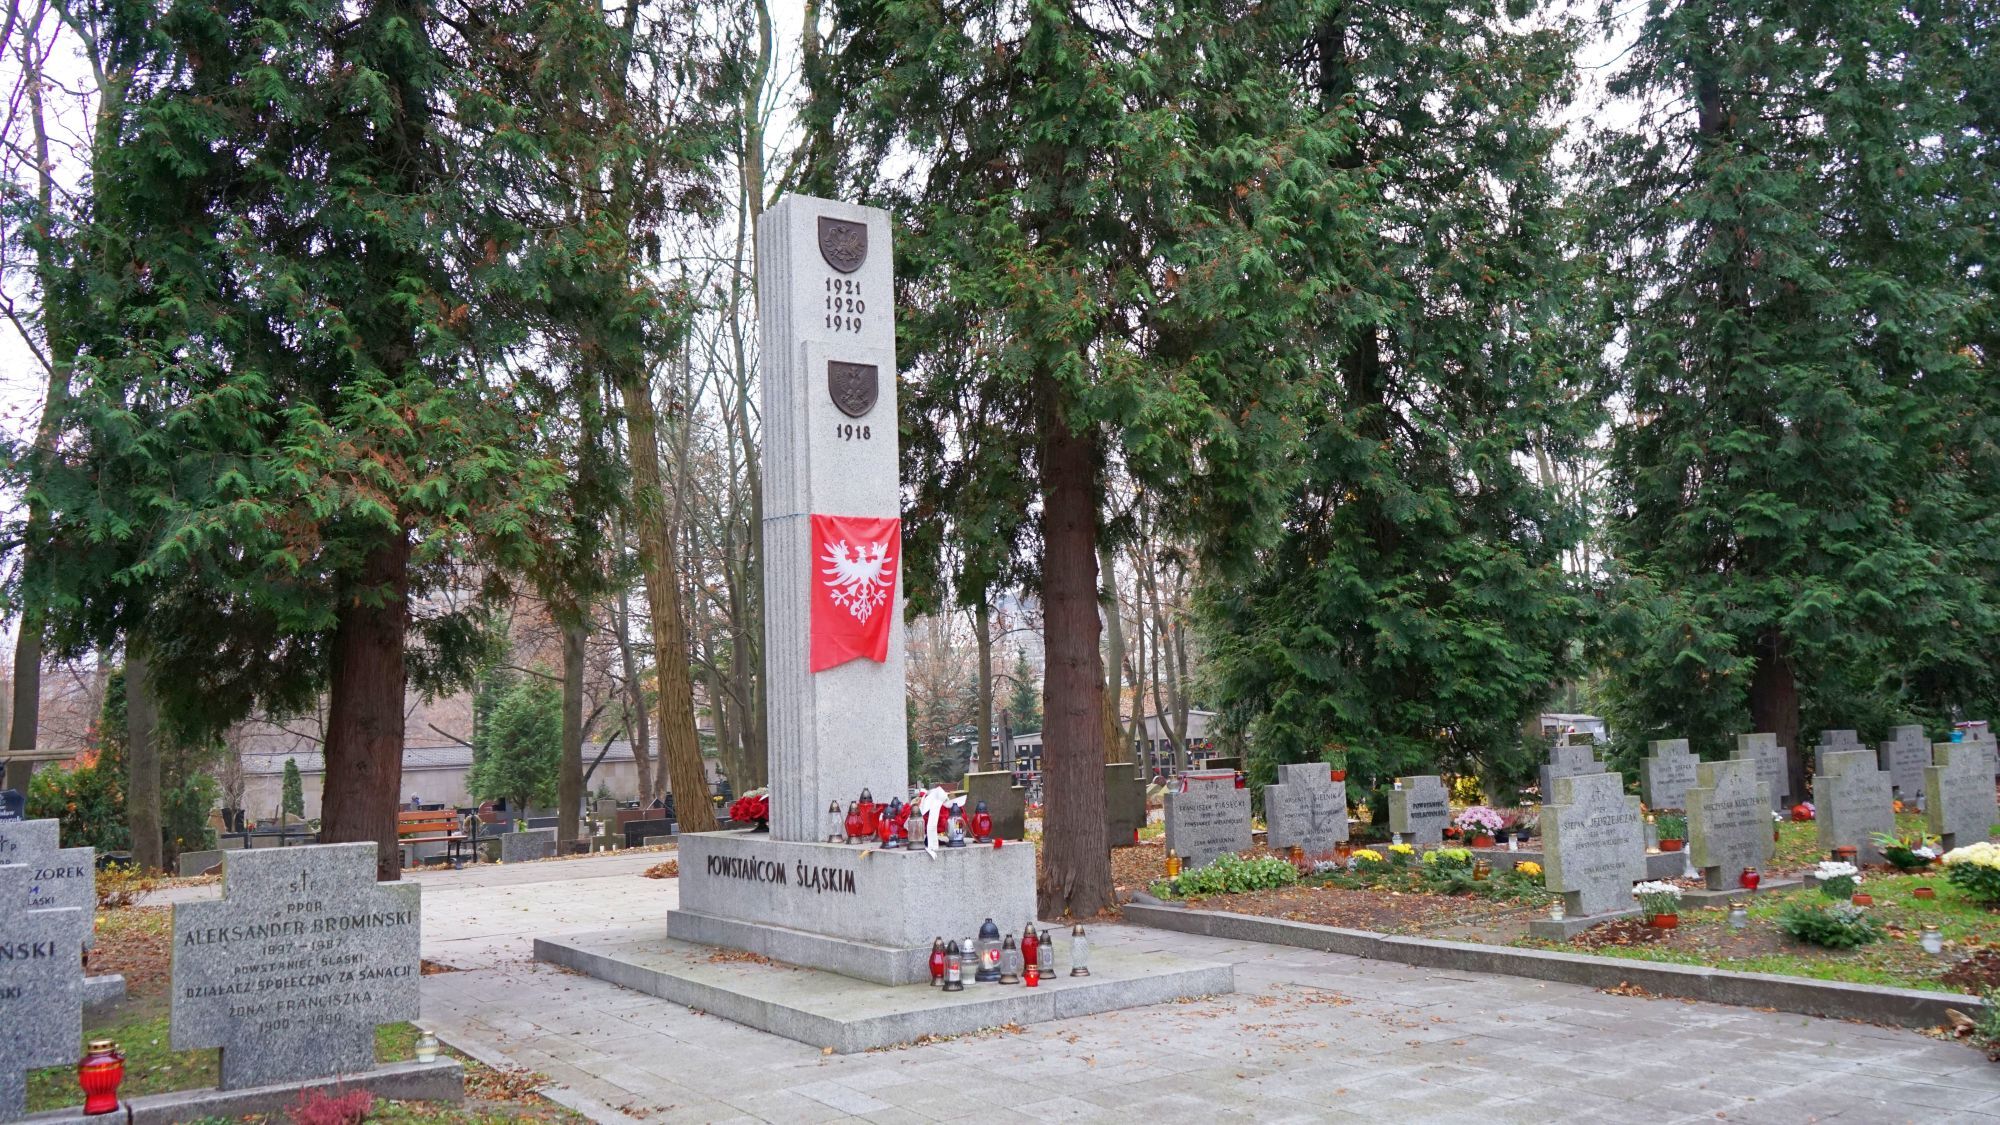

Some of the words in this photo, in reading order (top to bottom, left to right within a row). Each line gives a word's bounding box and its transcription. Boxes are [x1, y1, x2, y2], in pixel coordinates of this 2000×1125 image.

[825, 277, 861, 296] 1921
[825, 296, 866, 315] 1920
[825, 314, 862, 334] 1919
[836, 424, 871, 441] 1918
[707, 854, 787, 885] POWSTAŃCOM
[796, 858, 857, 895] ŚLĄSKIM
[287, 901, 323, 915] PPOR
[184, 921, 304, 947] ALEKSANDER
[311, 911, 412, 933] BROMIŃSKI
[262, 943, 294, 956] 1897
[234, 959, 313, 976] POWSTANIEC
[186, 982, 250, 999] DZIAŁACZ
[258, 973, 333, 991] SPOŁECZNY
[339, 971, 355, 983] ZA
[359, 965, 411, 981] SANACJI
[277, 991, 372, 1013] FRANCISZKA
[259, 1018, 290, 1033] 1900
